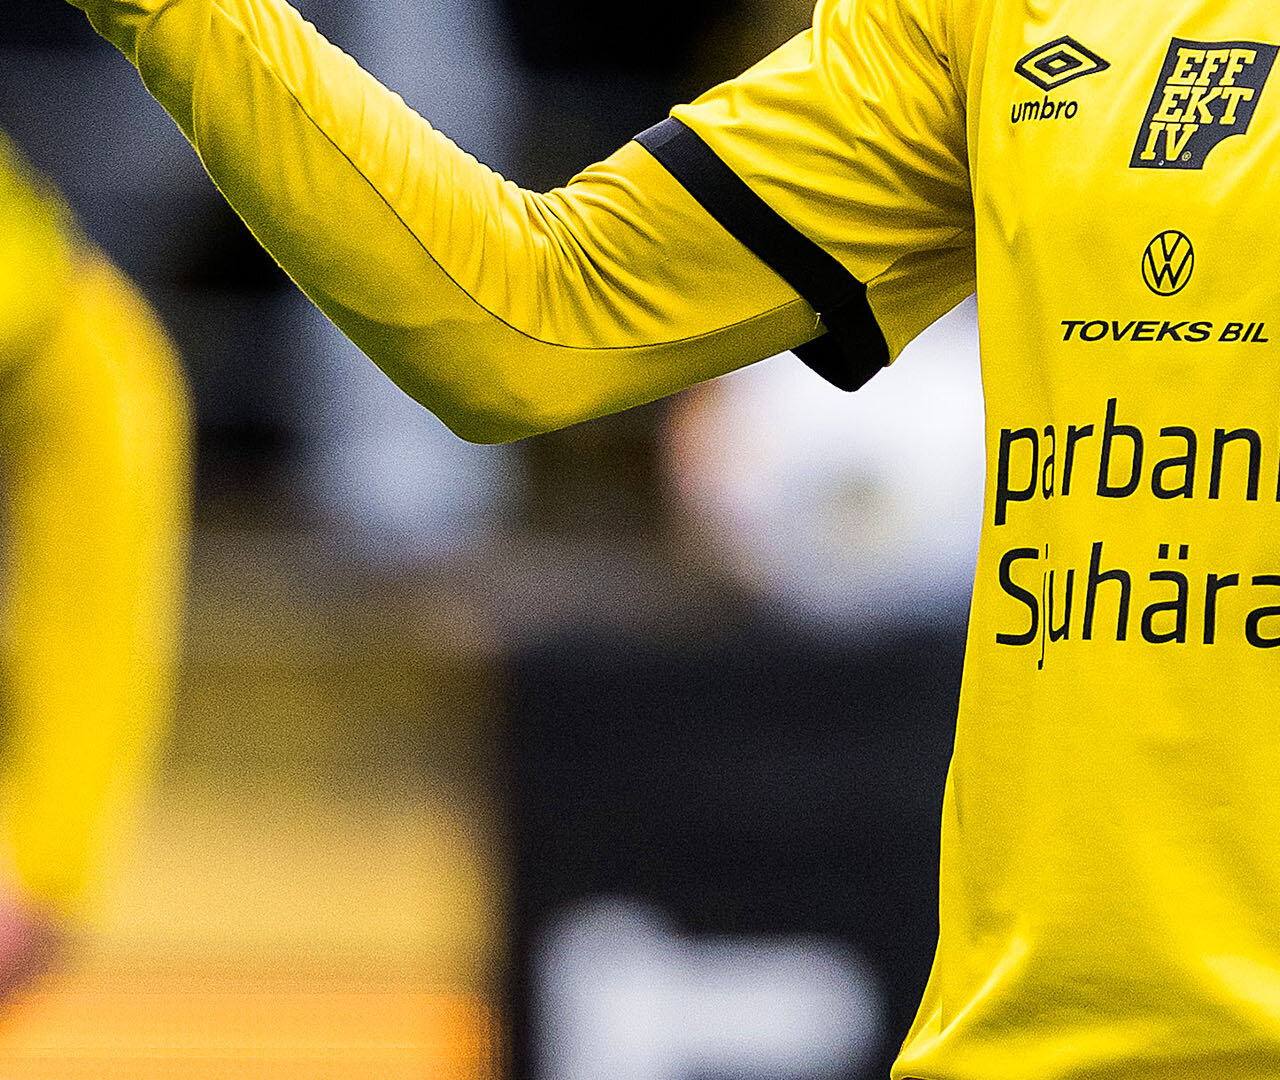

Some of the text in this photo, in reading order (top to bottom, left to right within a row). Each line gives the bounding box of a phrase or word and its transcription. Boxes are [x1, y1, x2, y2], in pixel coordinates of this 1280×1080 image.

[1166, 47, 1257, 86] EFF
[1011, 95, 1078, 124] umbro
[1152, 85, 1256, 125] EKT
[1060, 319, 1269, 343] TOVEKS BIL
